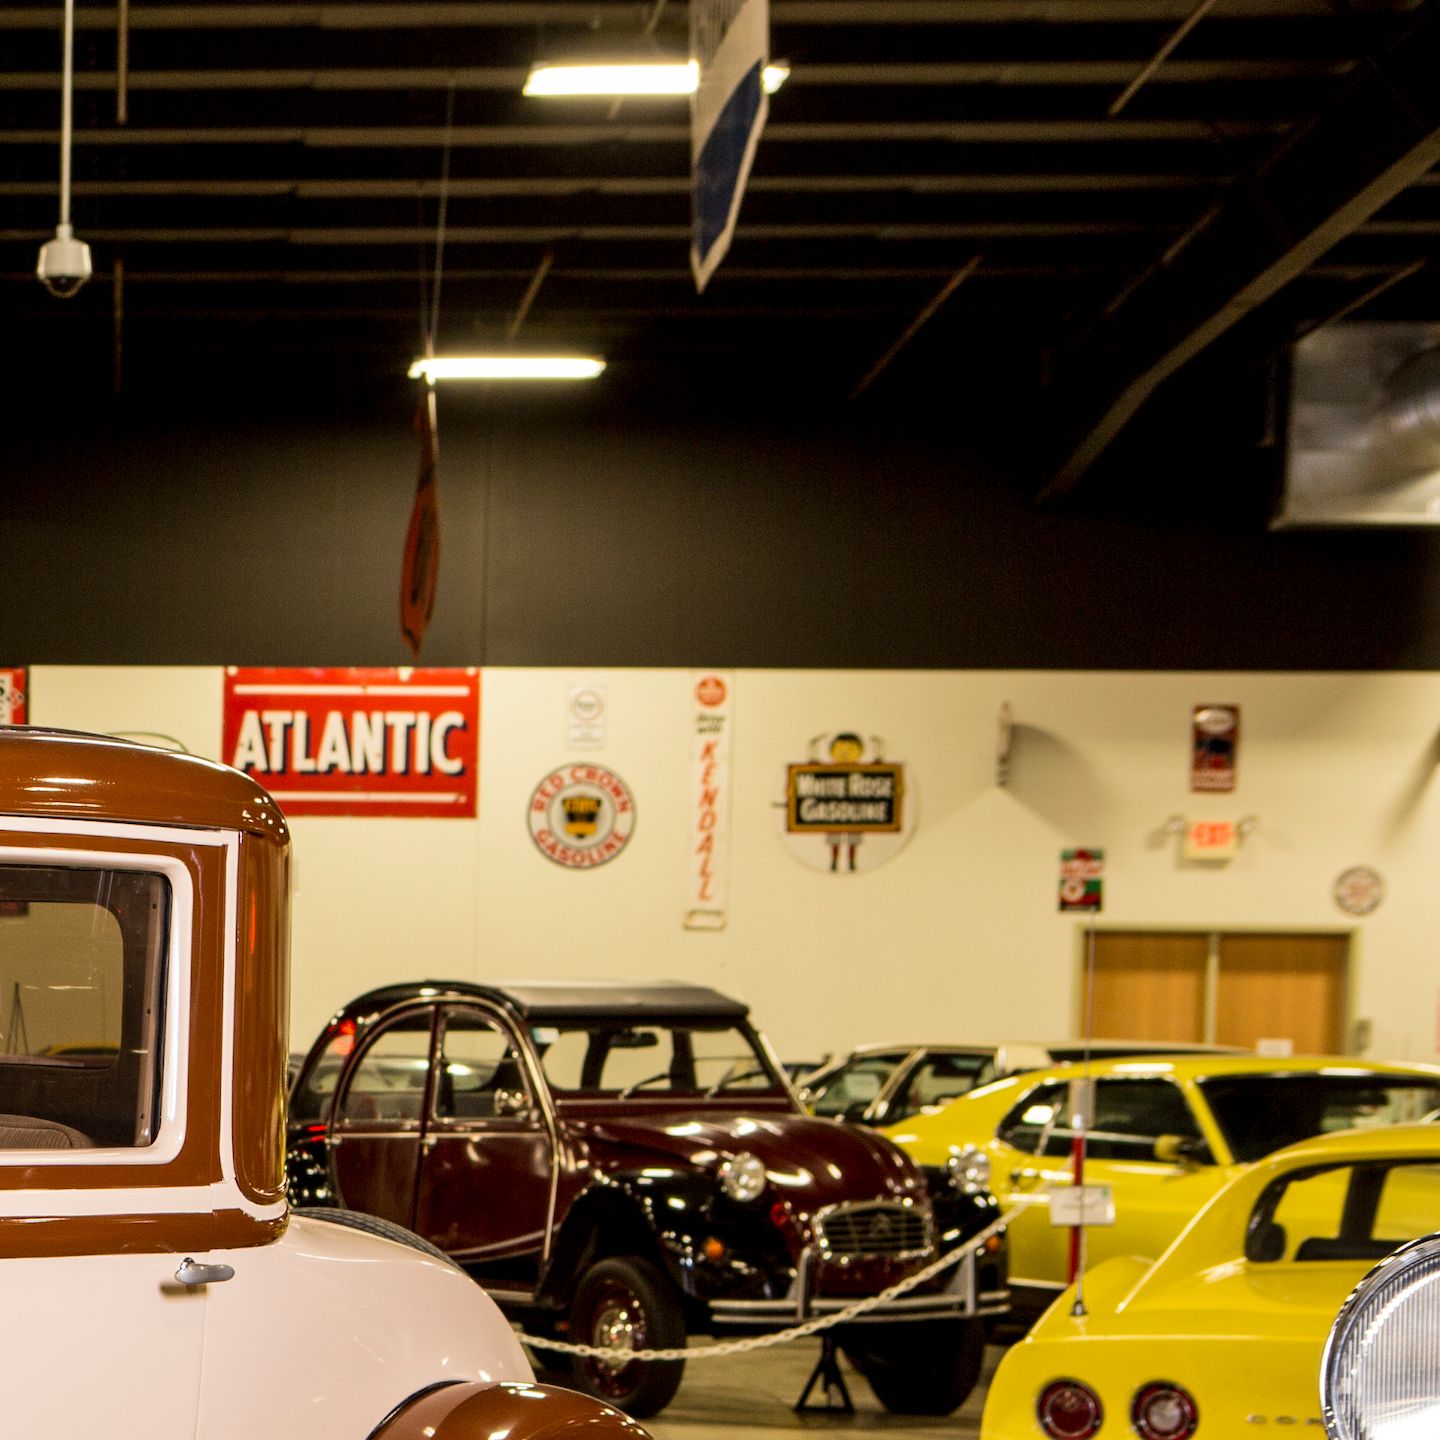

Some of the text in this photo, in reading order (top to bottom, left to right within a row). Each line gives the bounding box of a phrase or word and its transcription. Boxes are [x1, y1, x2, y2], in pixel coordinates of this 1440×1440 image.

[233, 710, 467, 776] ATLANTIC
[533, 765, 631, 813] RED CROWN
[536, 829, 625, 867] GASOLINE
[696, 741, 718, 902] KENDALL
